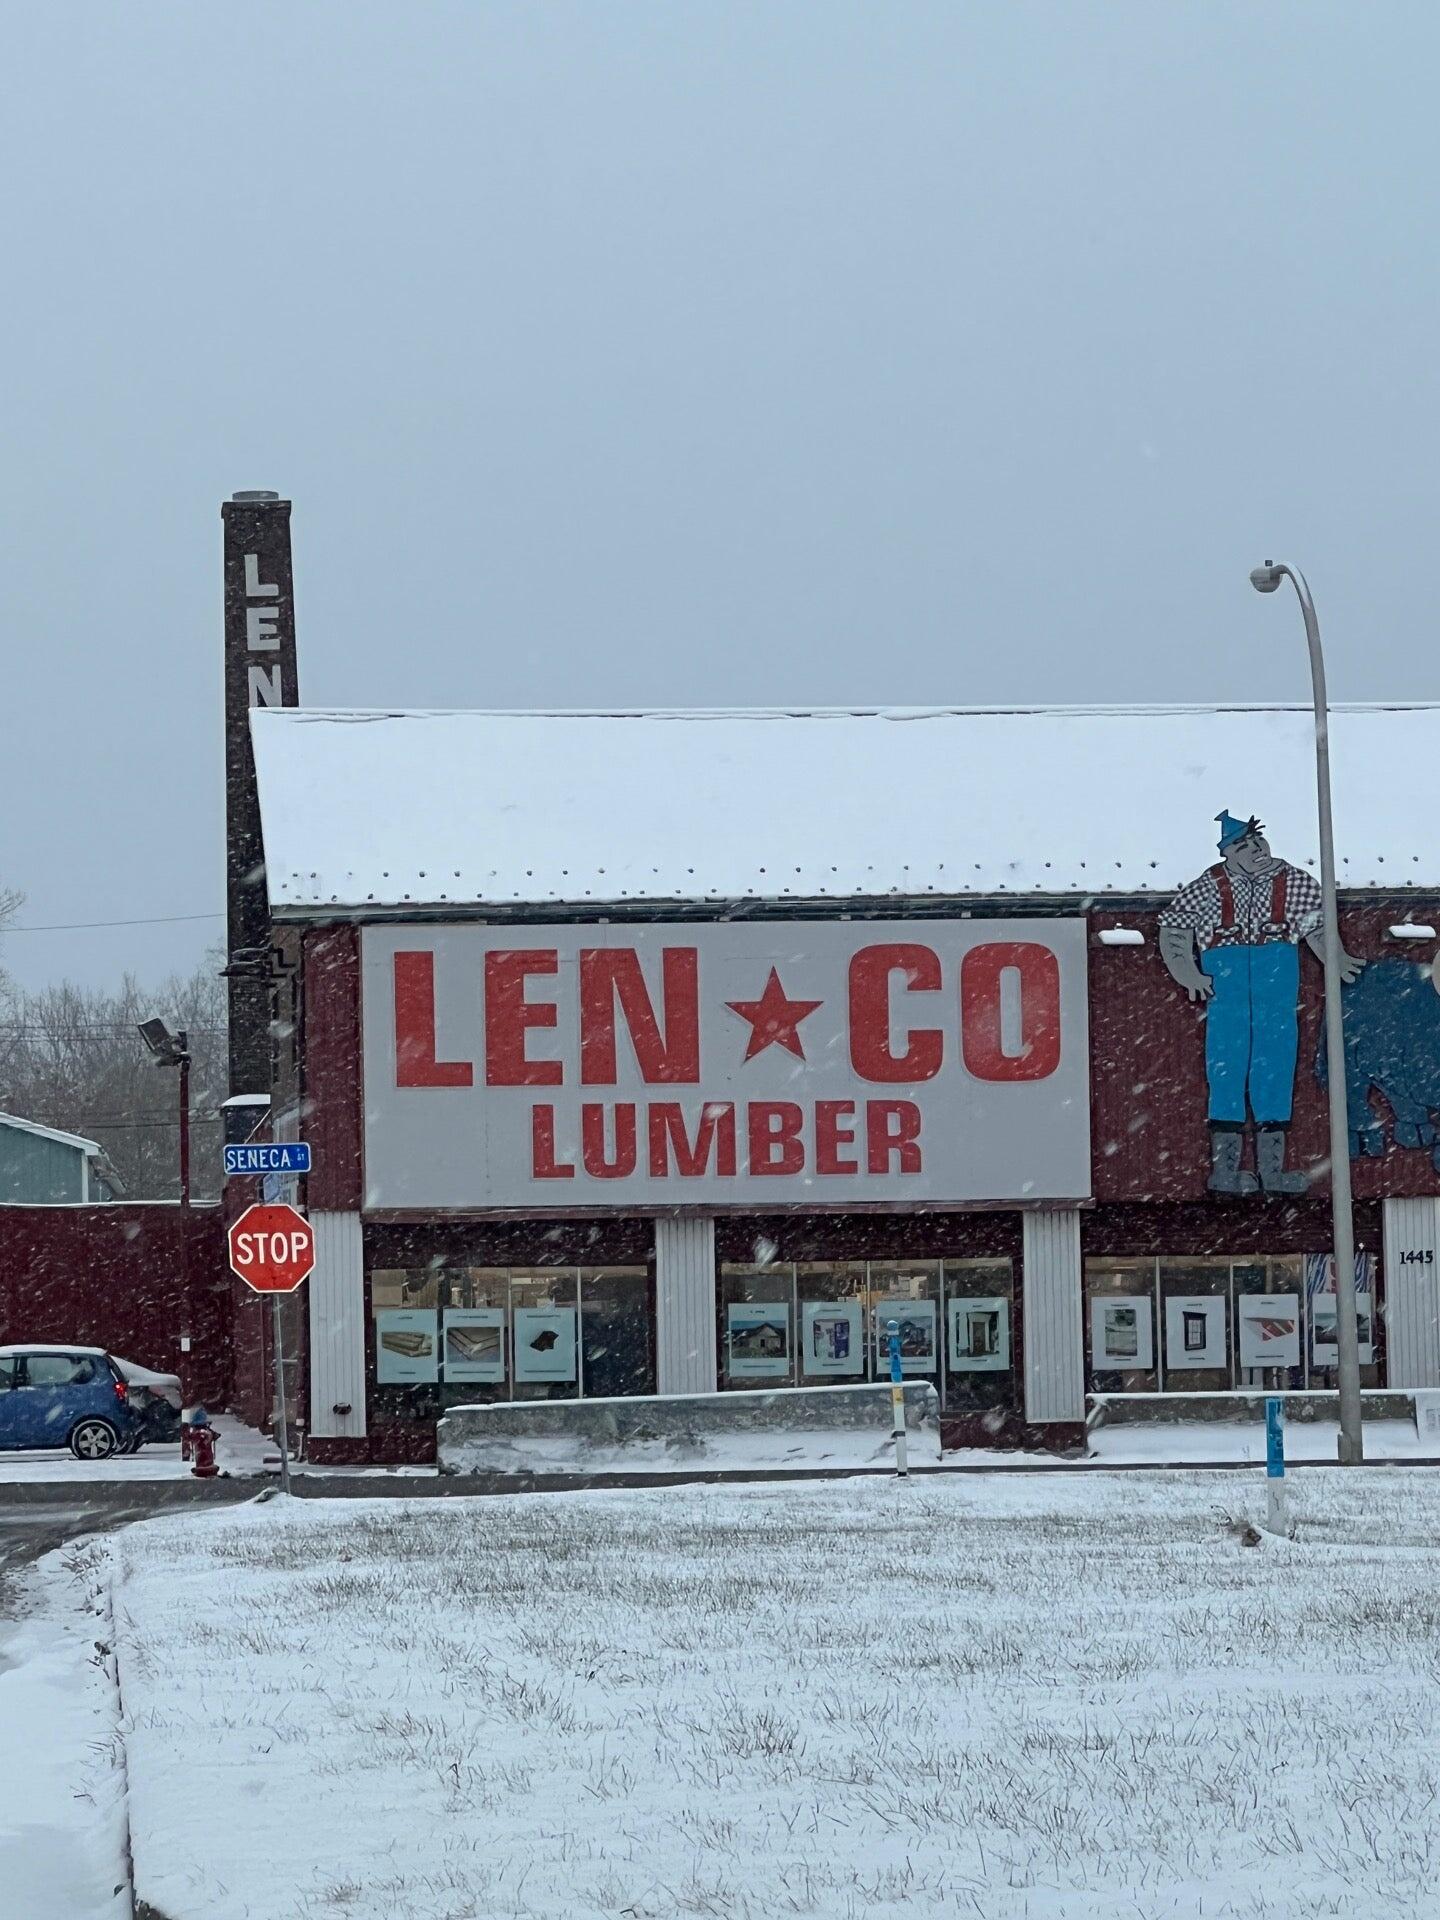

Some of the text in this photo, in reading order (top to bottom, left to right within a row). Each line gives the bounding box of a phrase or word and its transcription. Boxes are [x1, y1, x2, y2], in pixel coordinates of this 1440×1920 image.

[244, 554, 282, 707] LEN
[394, 942, 1061, 1087] LEN CO
[227, 1149, 291, 1169] SENECA
[532, 1100, 922, 1178] LUMBER
[236, 1232, 308, 1265] STOP
[1400, 1249, 1434, 1265] 1445
